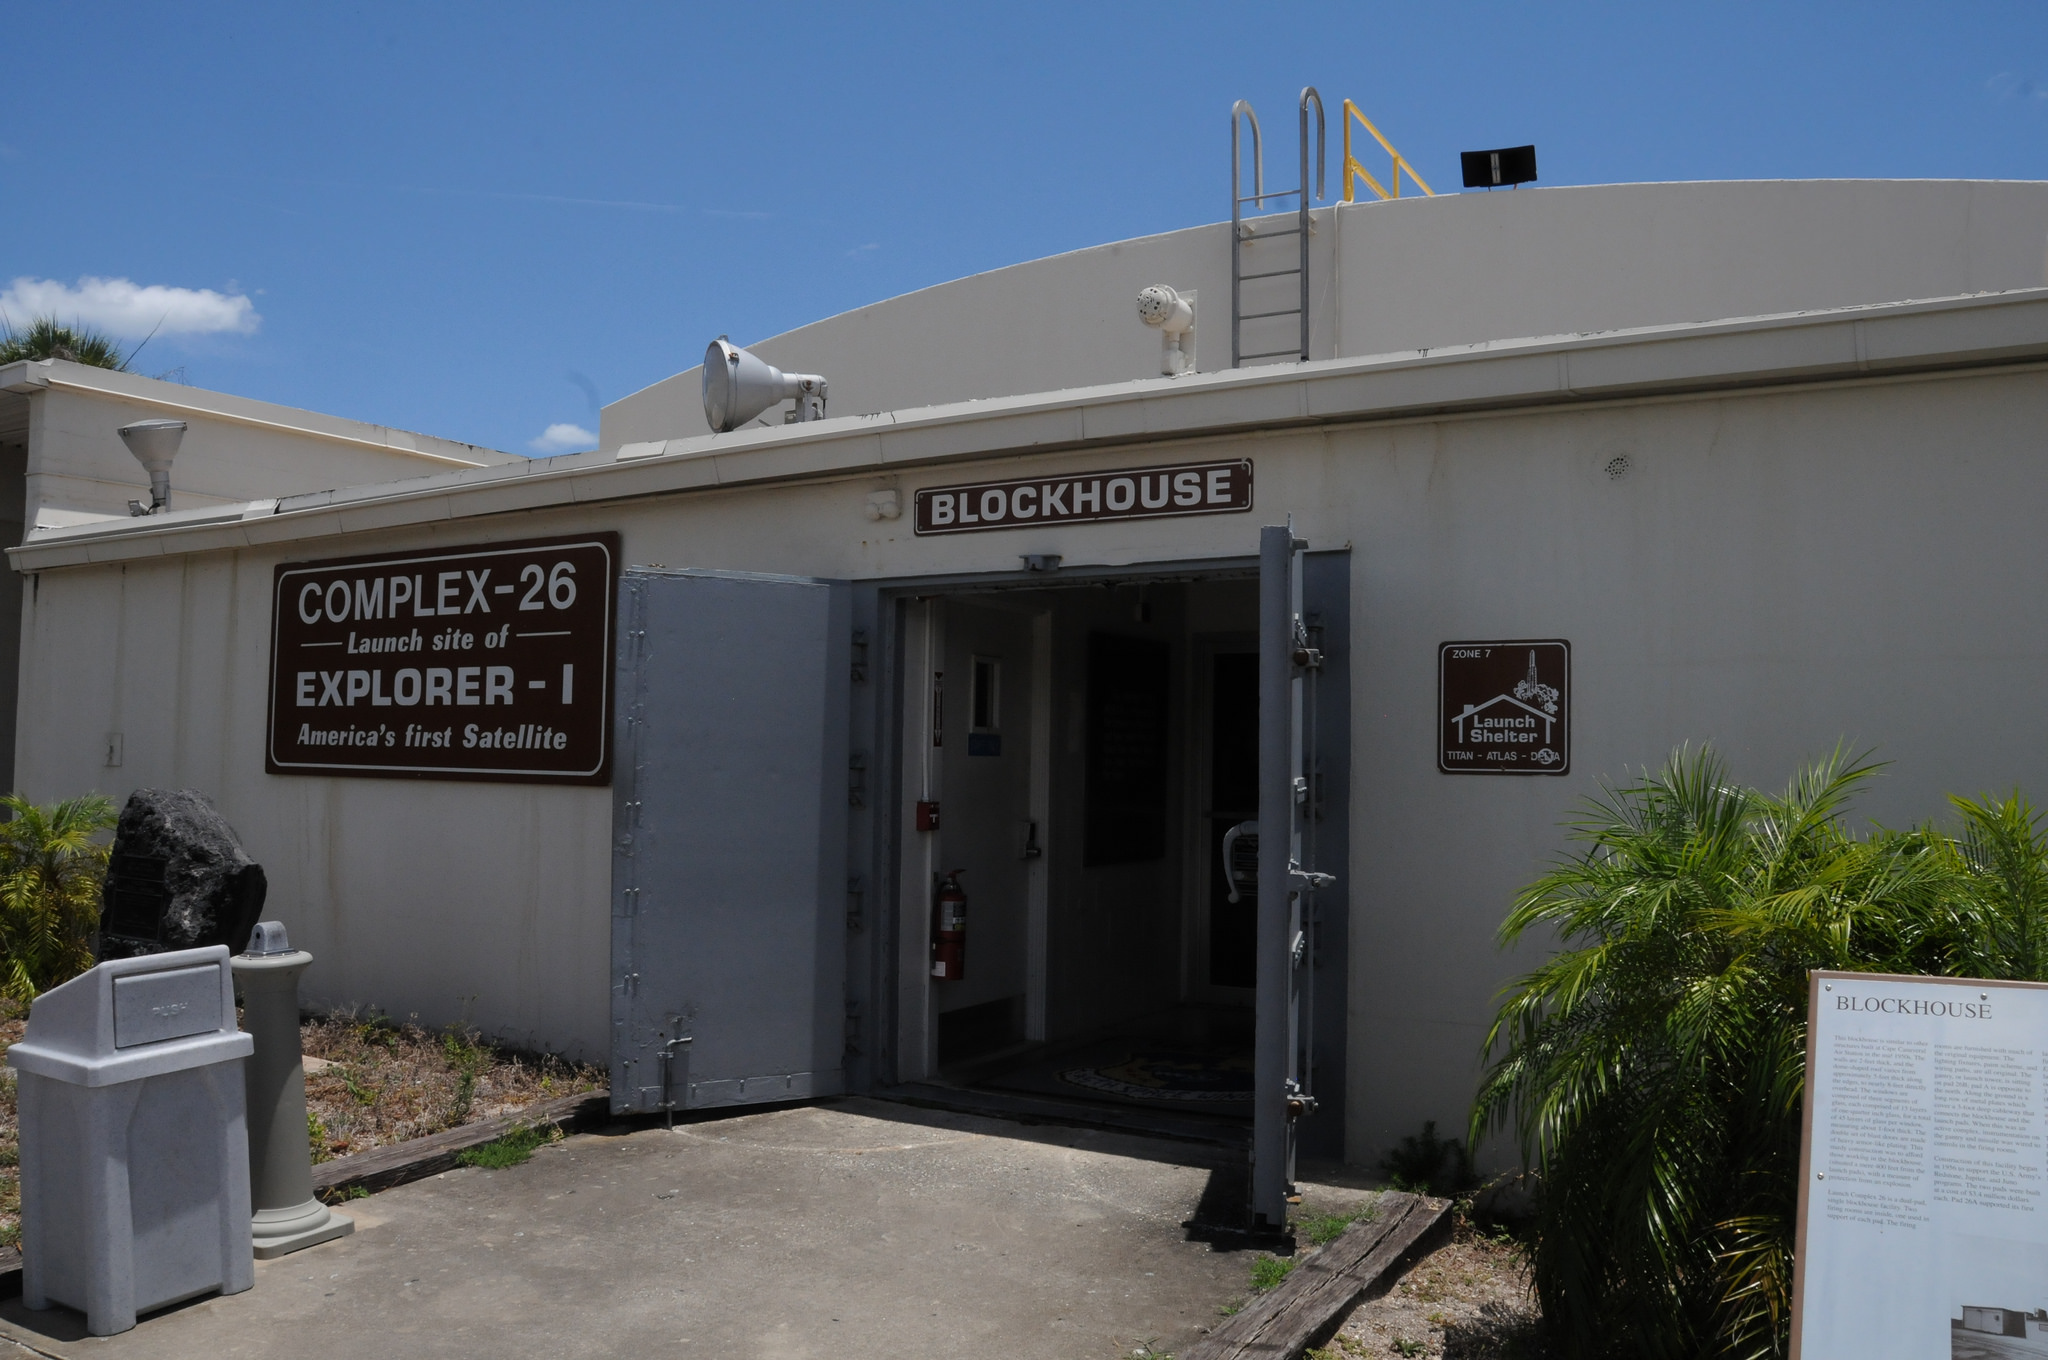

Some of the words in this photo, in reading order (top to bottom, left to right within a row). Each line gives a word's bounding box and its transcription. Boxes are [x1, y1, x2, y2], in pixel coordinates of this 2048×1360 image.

[931, 469, 1232, 526] BLOCKHOUSE
[298, 561, 577, 624] COMPLEX-26
[347, 628, 423, 654] Launch
[432, 628, 474, 650] site
[484, 624, 511, 648] of
[1452, 649, 1481, 659] ZONE
[1484, 649, 1492, 658] 7
[296, 665, 515, 707] EXPLORER
[1473, 714, 1535, 728] Launch
[296, 723, 396, 748] America's
[404, 724, 452, 748] first
[462, 724, 568, 750] Satellite
[1470, 729, 1538, 743] Shelter
[1446, 750, 1474, 760] TITAN
[1486, 751, 1518, 760] ATLAS
[1836, 996, 1993, 1020] BLOCKHOUSE
